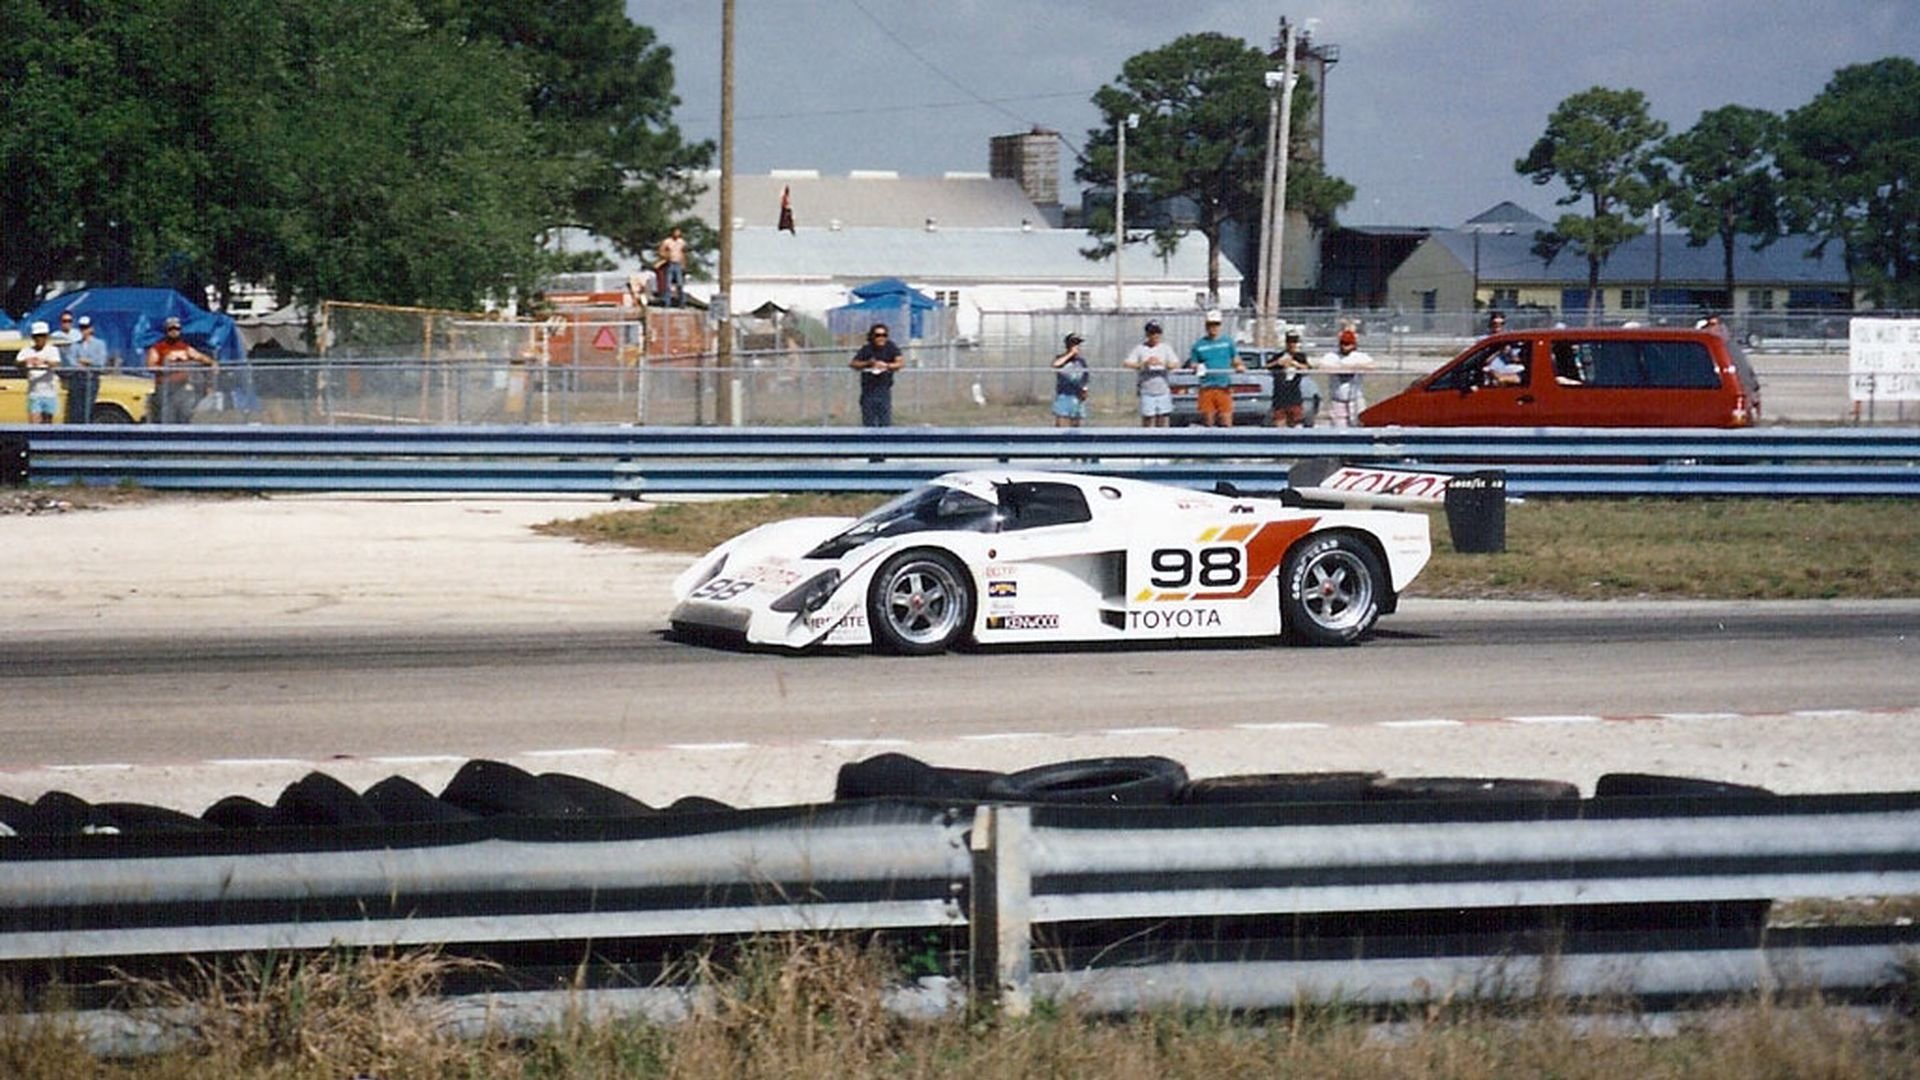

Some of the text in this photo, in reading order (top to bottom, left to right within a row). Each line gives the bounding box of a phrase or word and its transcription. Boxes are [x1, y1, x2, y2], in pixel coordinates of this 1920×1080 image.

[1332, 470, 1449, 498] TOYO
[1150, 546, 1241, 588] 98
[691, 578, 755, 600] 98
[1005, 614, 1059, 630] KENWOOD
[1129, 608, 1221, 629] TOYOTA
